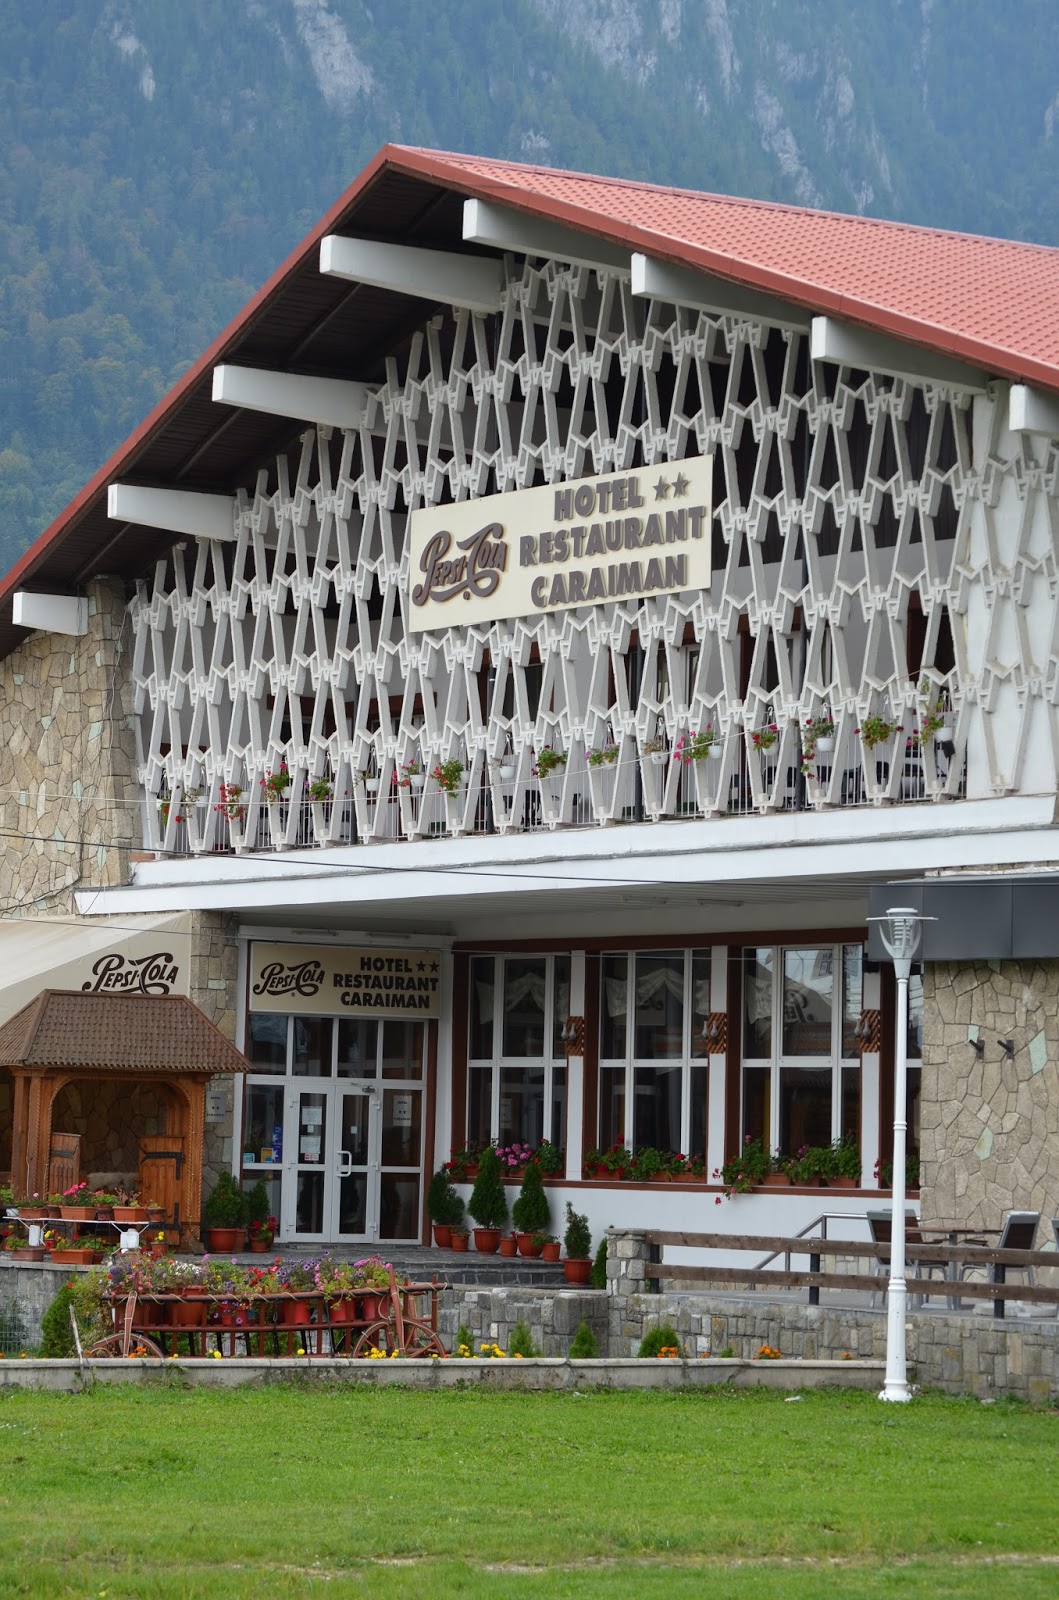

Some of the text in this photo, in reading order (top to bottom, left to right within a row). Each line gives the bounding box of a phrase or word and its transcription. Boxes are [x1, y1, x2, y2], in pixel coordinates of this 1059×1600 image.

[554, 477, 643, 521] HOTEL
[519, 507, 706, 566] RESTAURANT
[530, 554, 687, 608] CARAIMAN
[360, 956, 413, 973] HOTEL
[333, 974, 438, 992] RESTAURANT
[340, 992, 430, 1009] CARAIMAN
